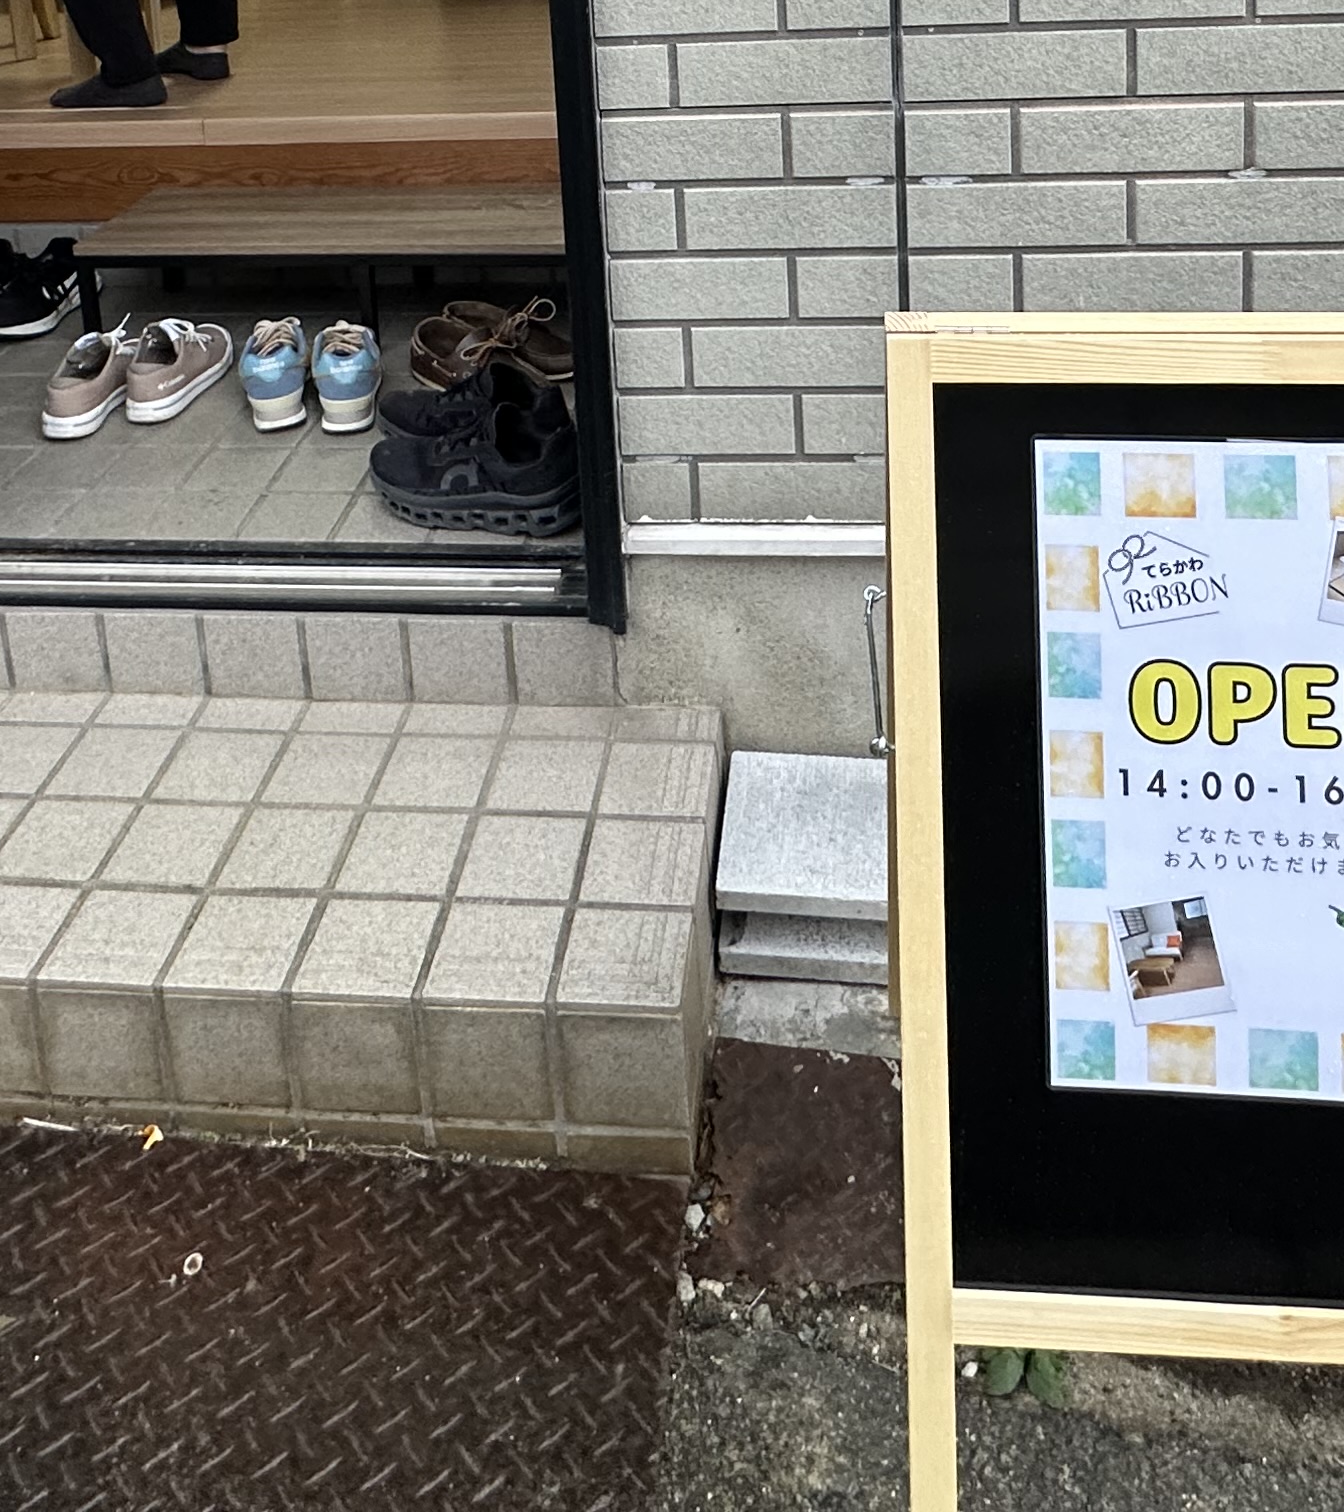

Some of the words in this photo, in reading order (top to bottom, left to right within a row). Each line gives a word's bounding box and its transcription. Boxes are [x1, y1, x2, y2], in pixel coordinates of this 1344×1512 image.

[1141, 557, 1204, 579] てらかわ
[1123, 573, 1229, 615] RiBBON
